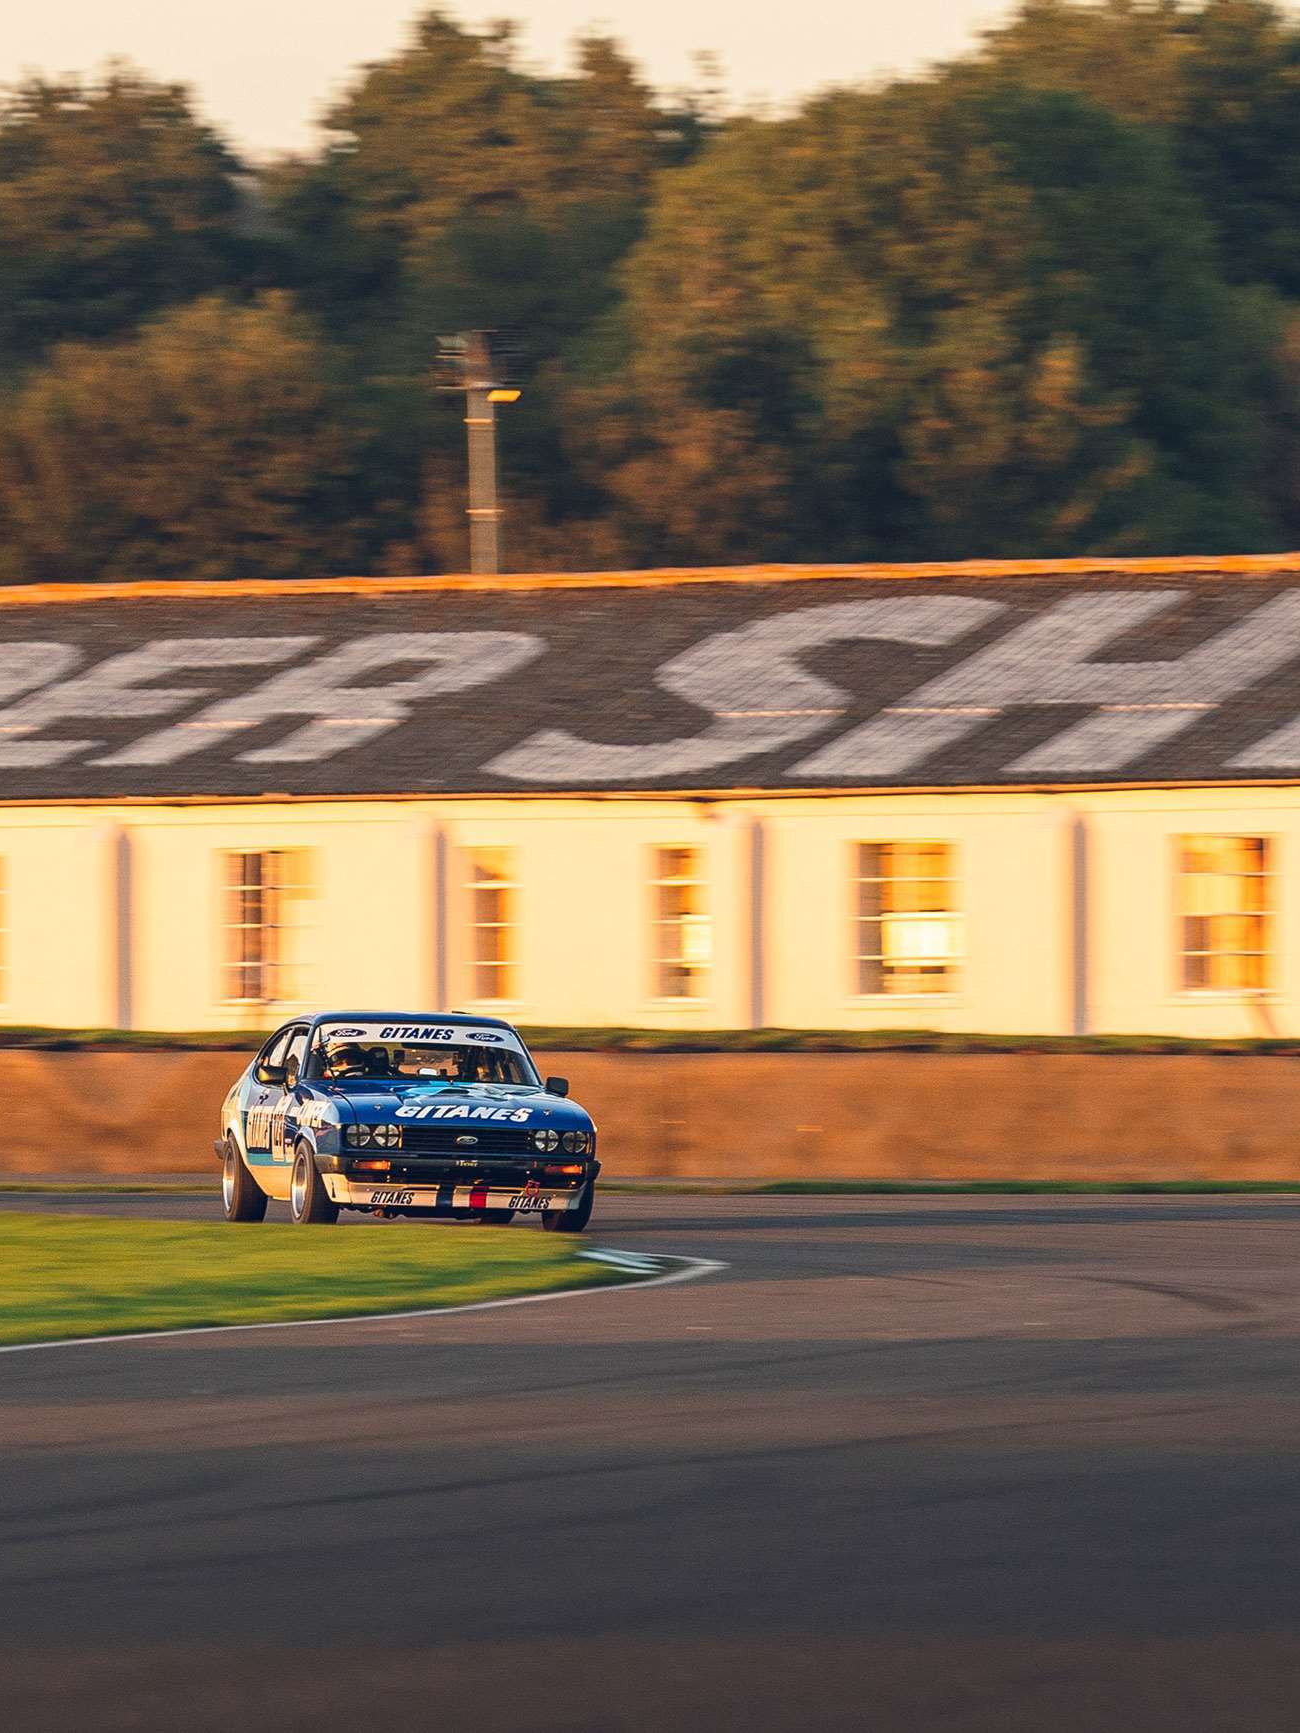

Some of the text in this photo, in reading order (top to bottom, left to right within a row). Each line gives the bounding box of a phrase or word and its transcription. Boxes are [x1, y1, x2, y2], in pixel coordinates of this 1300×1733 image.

[479, 587, 1300, 781] SH
[379, 1027, 454, 1040] GITANES
[394, 1104, 534, 1122] GITANES
[370, 1191, 415, 1205] GITANES
[507, 1195, 552, 1209] GITANES
